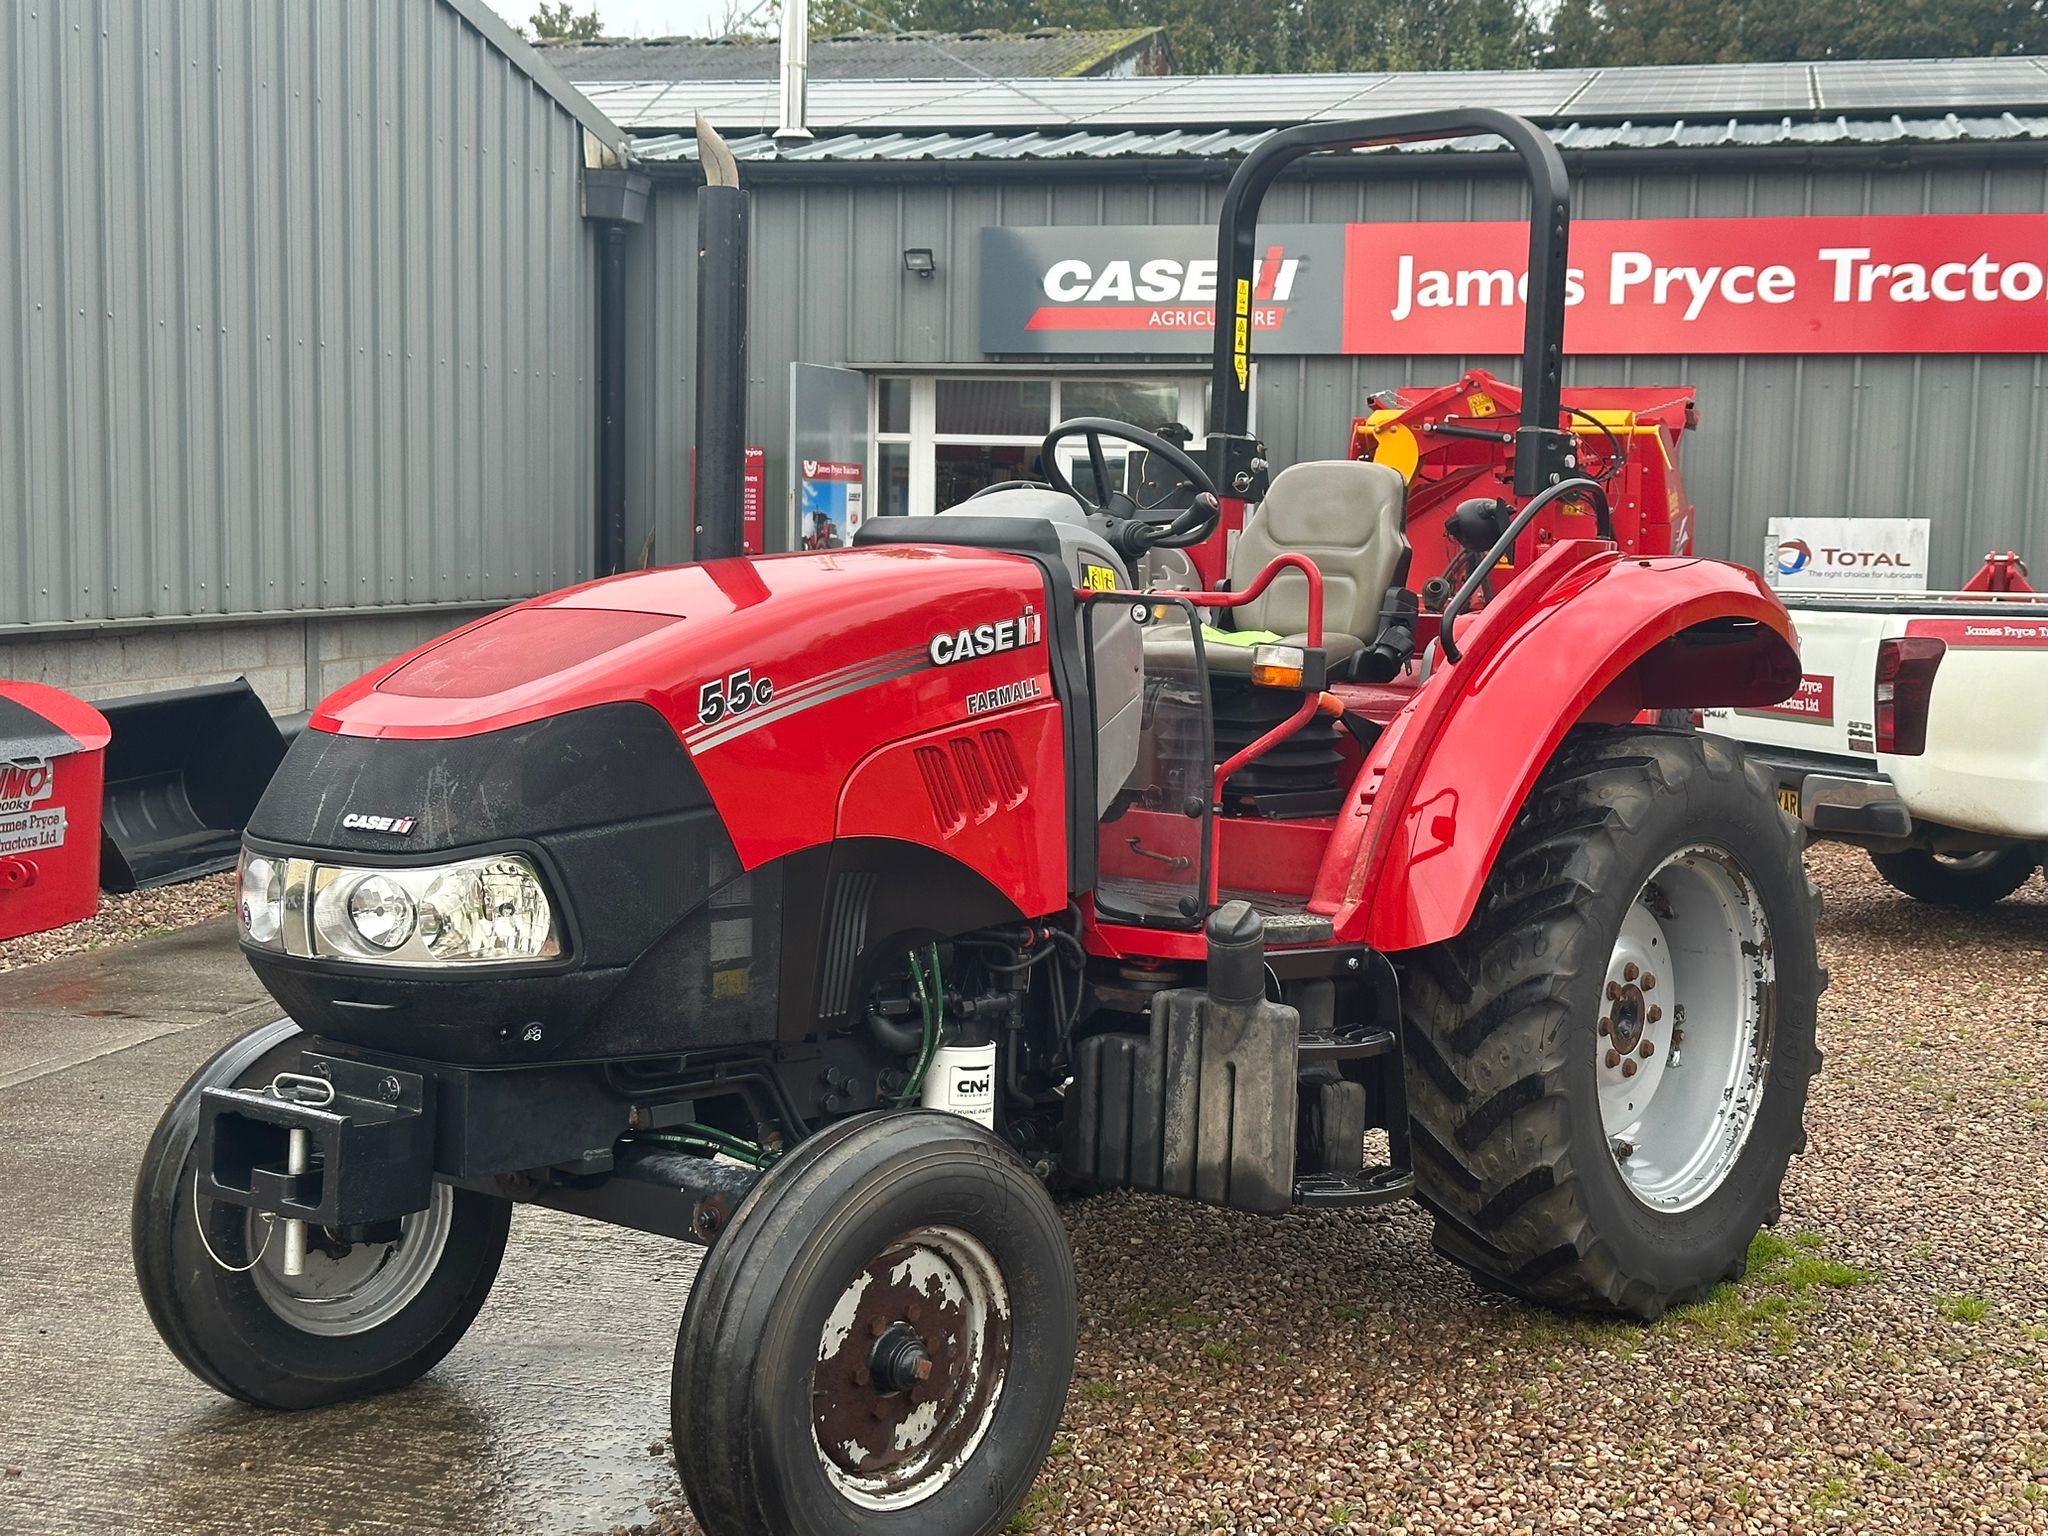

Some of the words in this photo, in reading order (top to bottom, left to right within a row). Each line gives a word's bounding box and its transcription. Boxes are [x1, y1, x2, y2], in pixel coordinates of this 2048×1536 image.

[1043, 259, 1218, 302] CASE
[1610, 251, 1796, 321] Pryce
[1818, 247, 2048, 302] Tracto
[1149, 310, 1277, 327] AGRICURE
[1821, 548, 1911, 567] TOTAL
[1824, 570, 1843, 579] right
[1844, 570, 1870, 578] choice
[1884, 571, 1923, 579] lubricants
[1965, 625, 2003, 636] James
[2004, 626, 2036, 638] Pryce
[929, 619, 1014, 666] CASE
[966, 678, 1042, 716] FARMALL
[1805, 698, 1820, 712] Ltd
[29, 814, 60, 830] Pryce
[343, 813, 394, 831] CASE
[0, 836, 38, 852] ractors
[40, 829, 57, 846] Ltd
